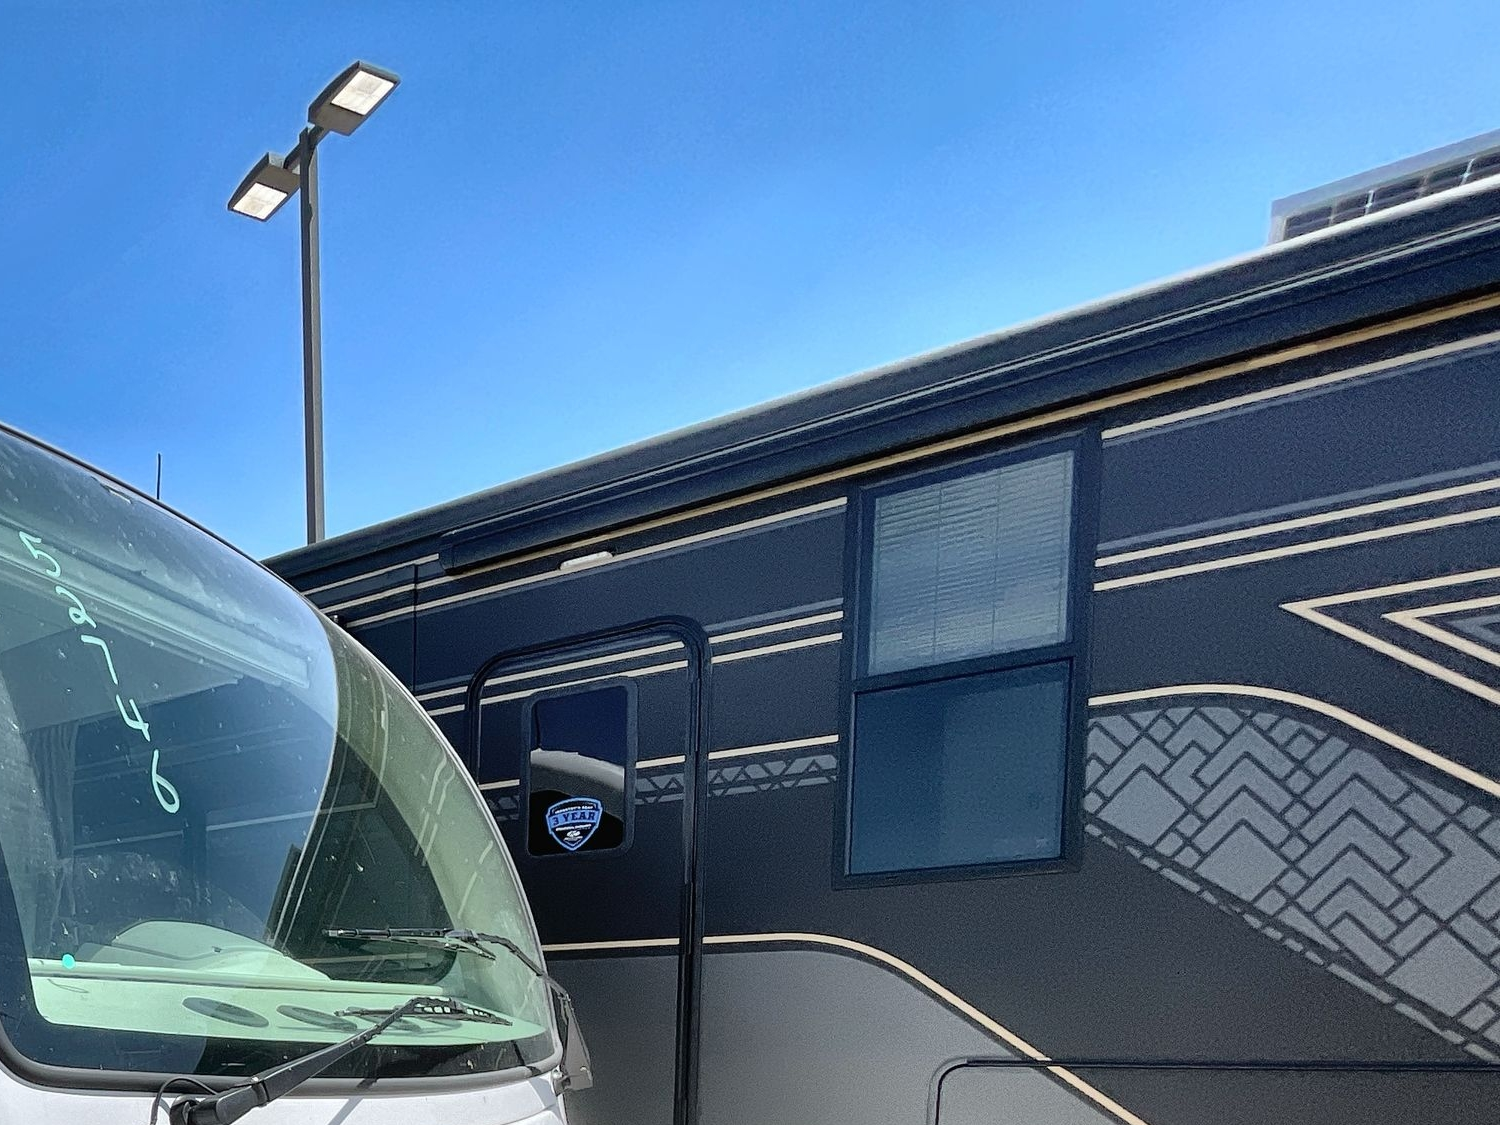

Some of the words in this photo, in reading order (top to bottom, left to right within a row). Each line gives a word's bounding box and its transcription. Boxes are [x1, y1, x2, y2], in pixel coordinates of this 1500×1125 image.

[18, 530, 181, 815] 52746
[552, 817, 559, 825] 3
[563, 812, 595, 821] YEAR
